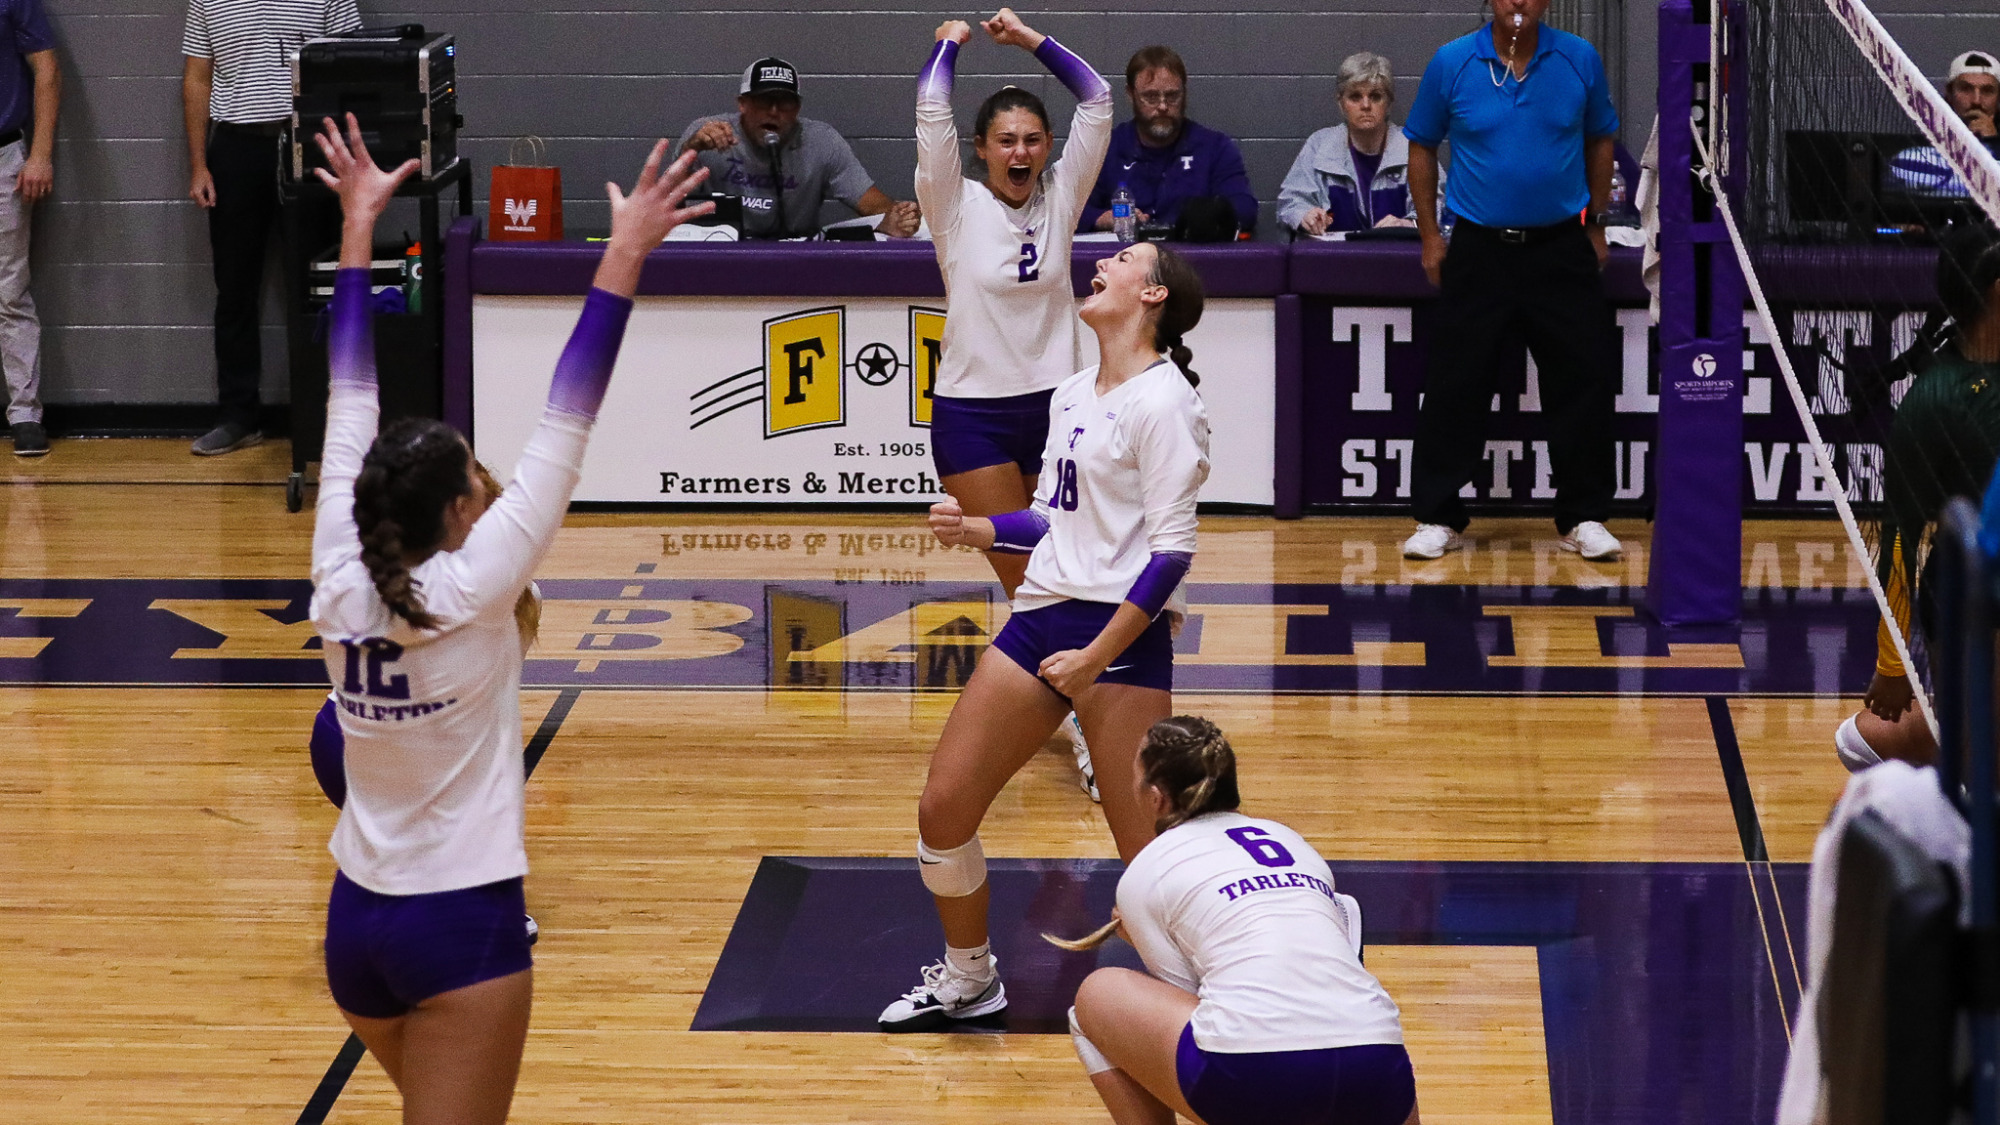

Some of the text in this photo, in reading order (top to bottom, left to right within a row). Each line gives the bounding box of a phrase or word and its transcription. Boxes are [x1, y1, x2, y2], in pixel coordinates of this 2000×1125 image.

[760, 66, 794, 81] TEXANS
[1181, 155, 1194, 170] T
[741, 196, 773, 210] WAC
[1018, 243, 1039, 283] 2
[783, 336, 826, 405] F
[833, 443, 926, 457] Est. 1905
[1342, 438, 1557, 498] STTE
[659, 472, 791, 494] Farmers
[803, 472, 828, 494] &
[1048, 458, 1079, 512] 18
[339, 637, 411, 700] 12
[1224, 826, 1295, 868] 6
